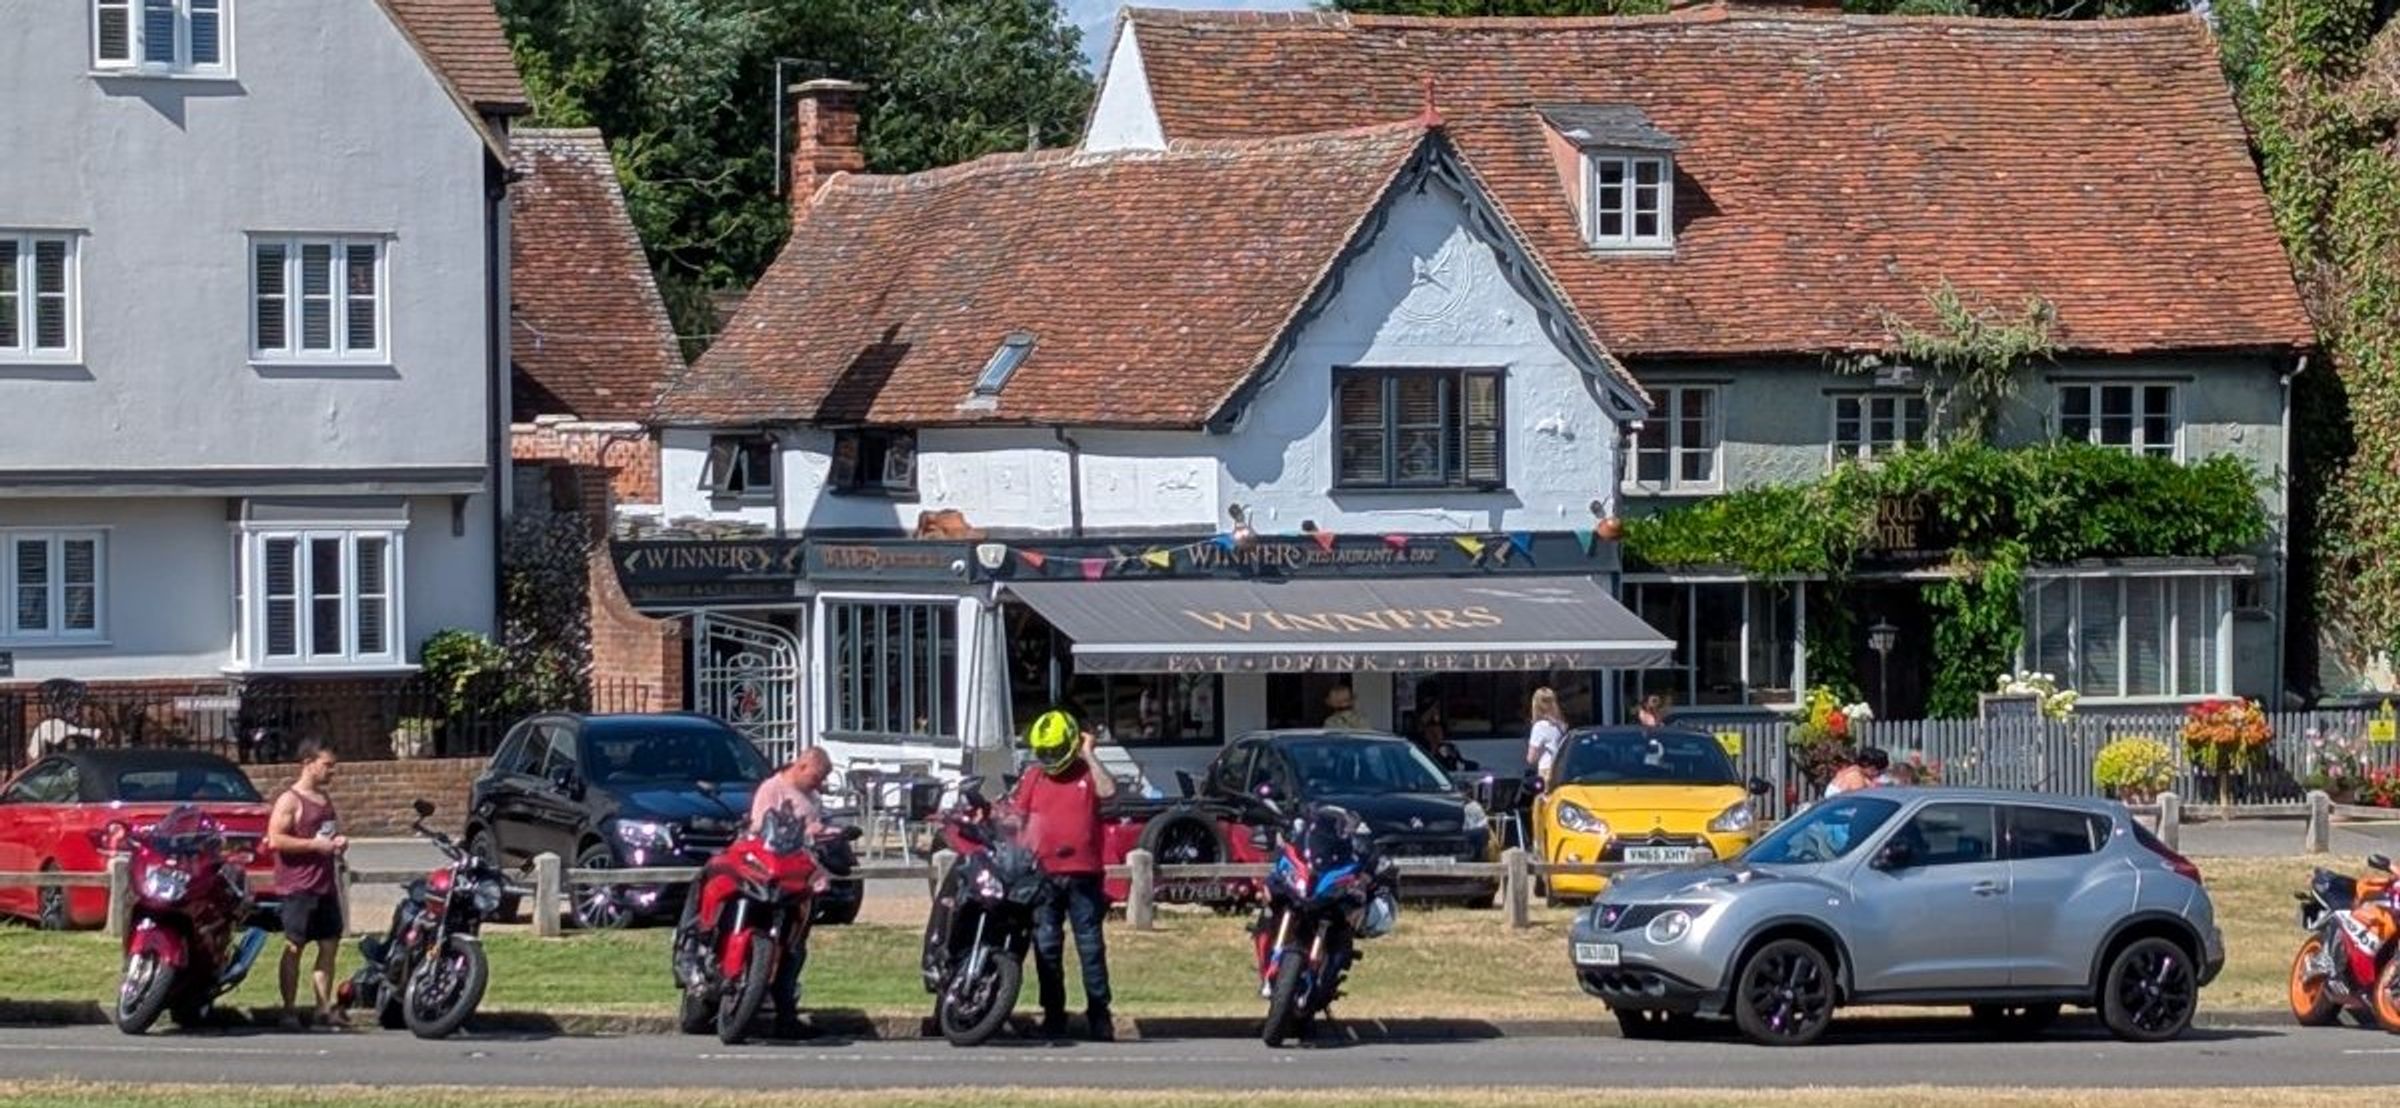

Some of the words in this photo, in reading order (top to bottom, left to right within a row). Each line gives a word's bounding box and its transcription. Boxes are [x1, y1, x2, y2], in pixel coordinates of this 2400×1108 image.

[1880, 497, 1925, 525] IQUES
[1187, 543, 1300, 568] WINNERS
[1306, 549, 1393, 566] RESTAURANT
[1184, 606, 1503, 632] WINNERS
[1167, 655, 1227, 671] EAT
[1271, 655, 1378, 670] DRINK
[1423, 655, 1457, 669] BE
[1473, 653, 1581, 668] HAPPY
